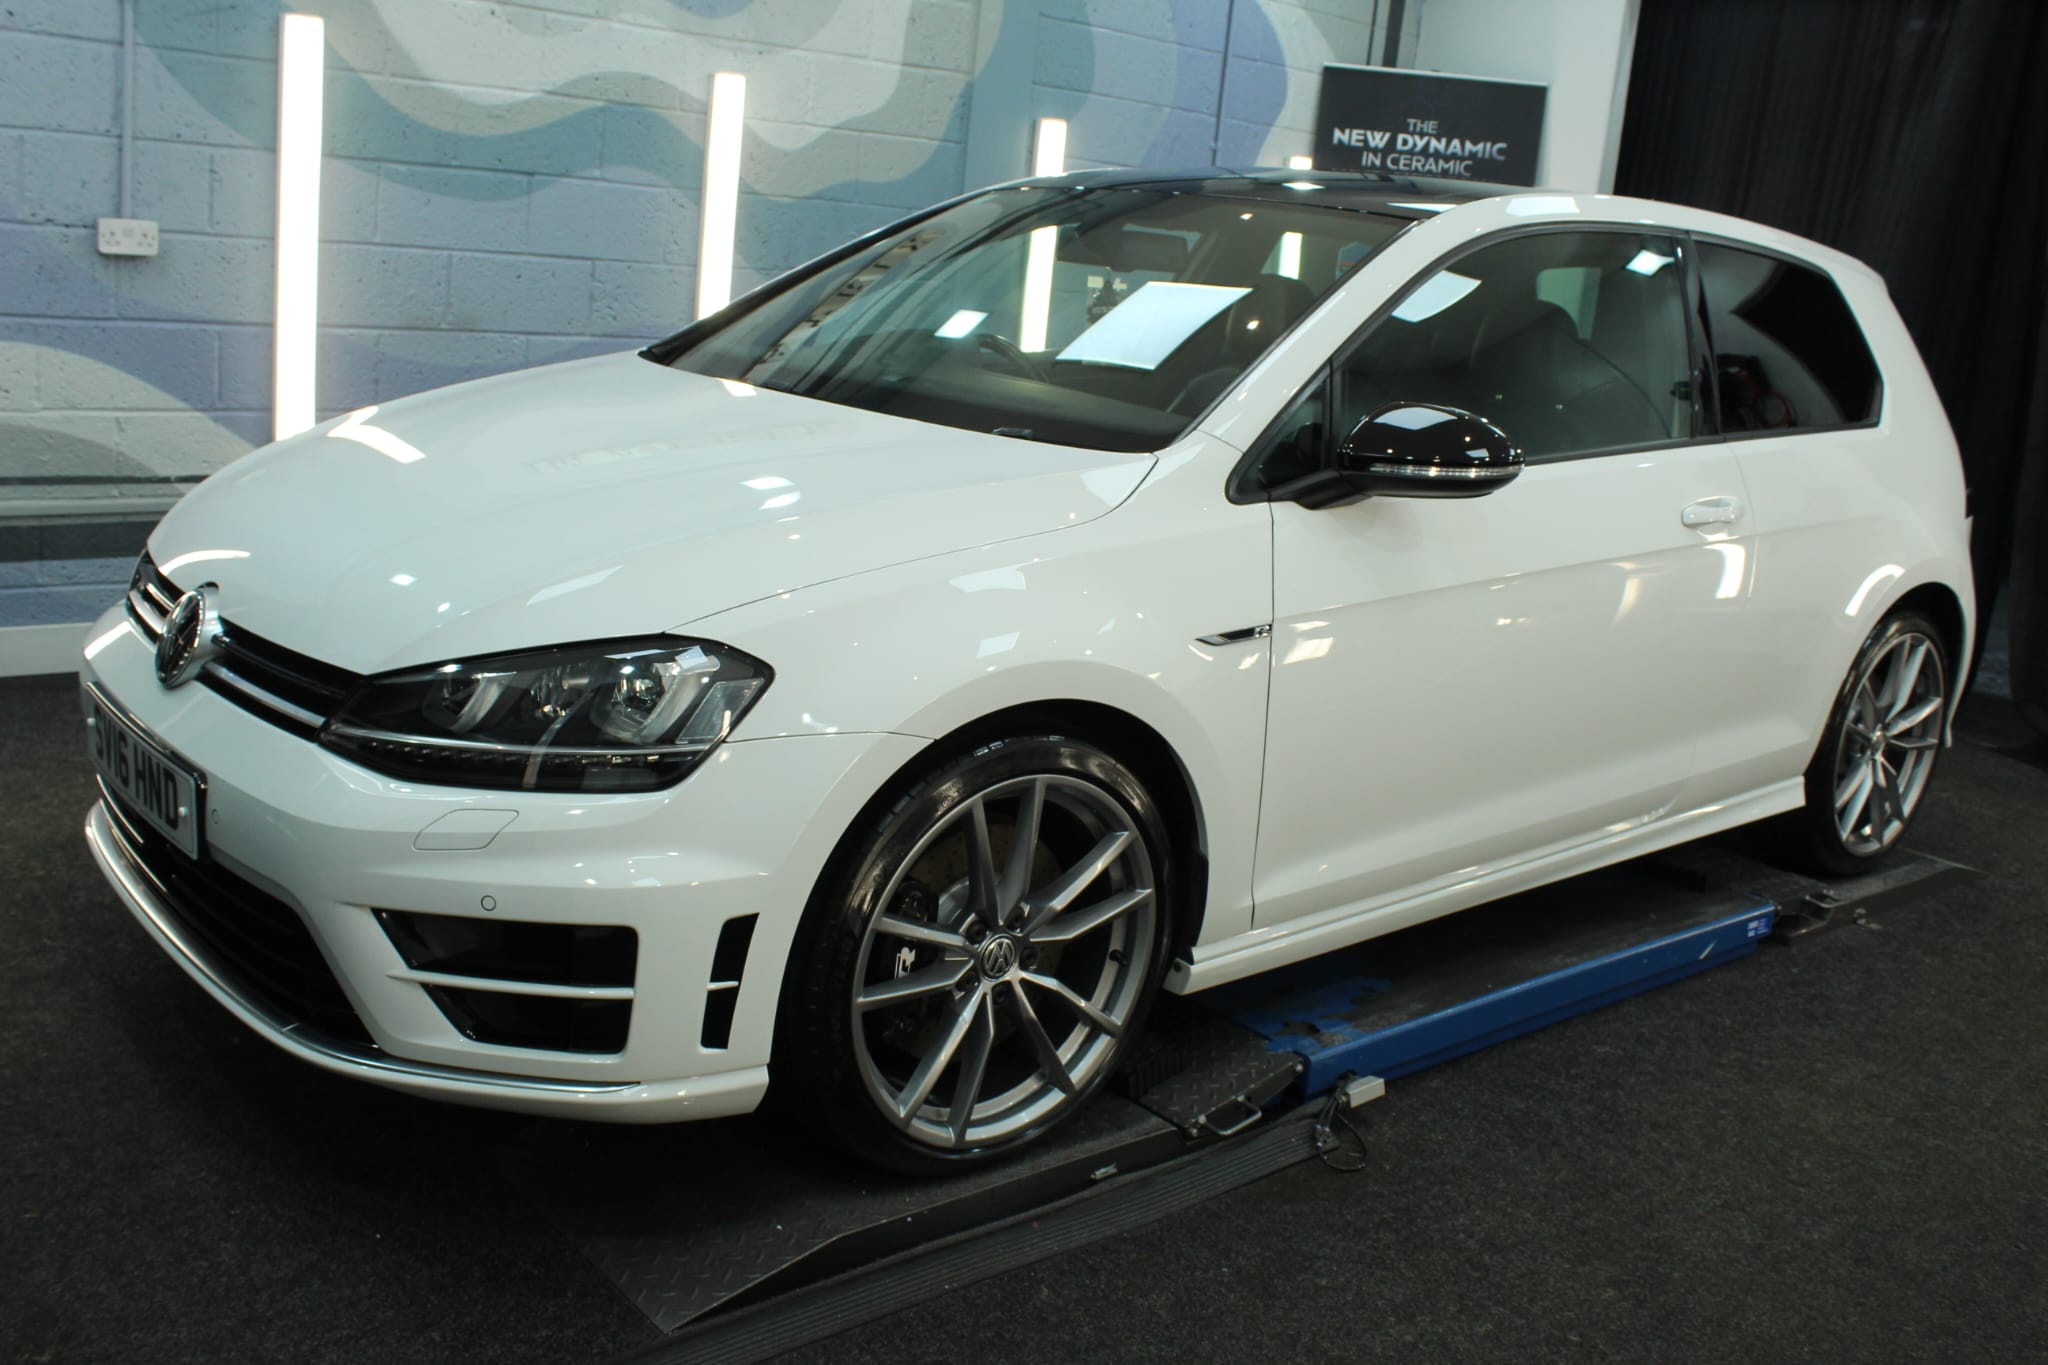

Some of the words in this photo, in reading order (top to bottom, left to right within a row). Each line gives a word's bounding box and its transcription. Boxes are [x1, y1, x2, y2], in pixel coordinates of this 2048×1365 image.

[1406, 118, 1439, 134] THE
[1332, 127, 1391, 150] NEW
[1396, 133, 1508, 161] DYNAMIC
[1361, 151, 1382, 168] IN
[1386, 153, 1473, 177] CERAMIC
[134, 742, 179, 831] HND
